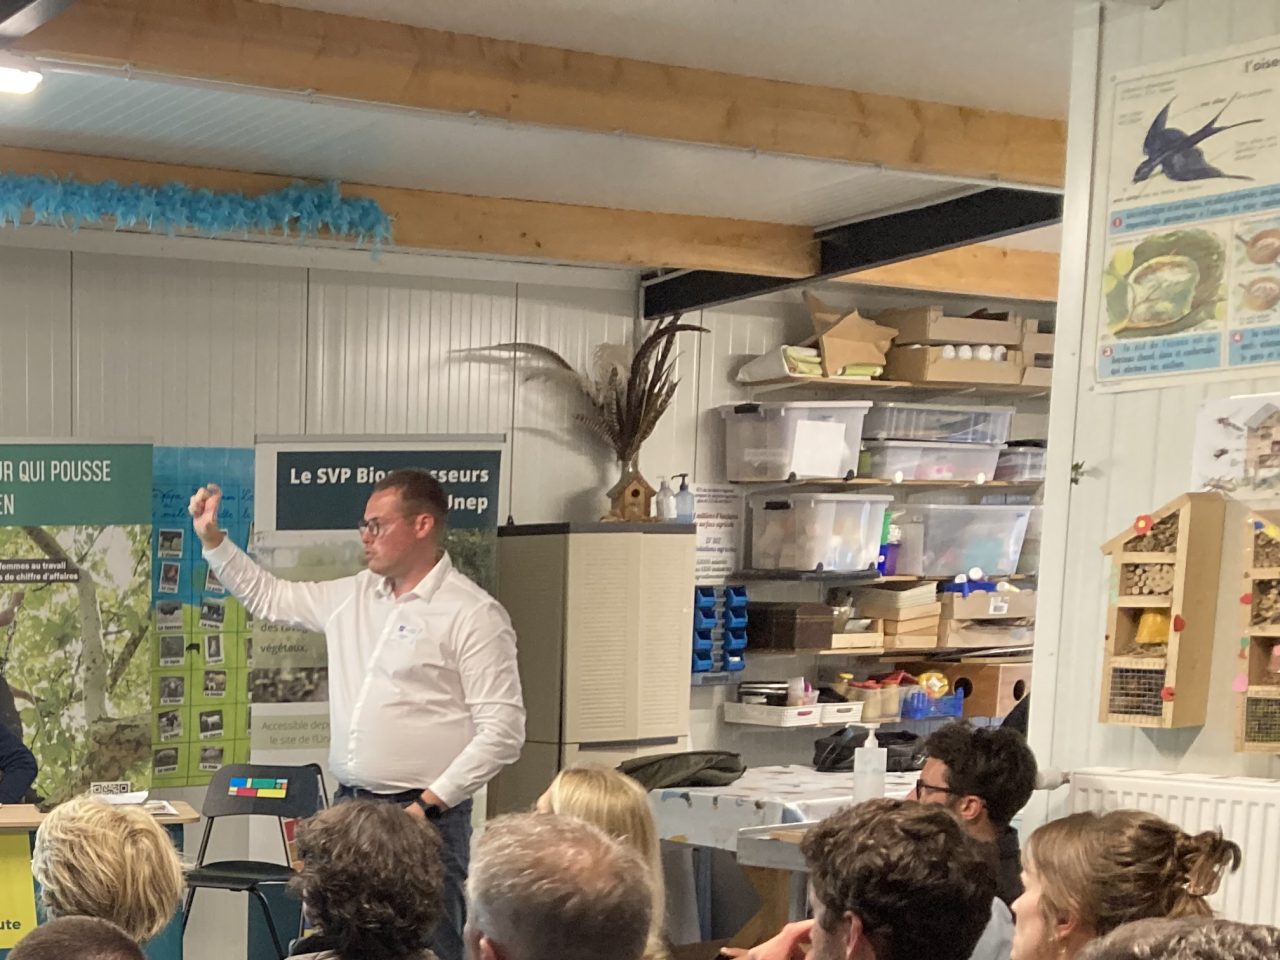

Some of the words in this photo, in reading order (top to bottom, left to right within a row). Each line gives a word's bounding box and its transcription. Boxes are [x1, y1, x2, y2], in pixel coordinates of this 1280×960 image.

[19, 460, 45, 483] QUI
[51, 460, 111, 482] POUSSE
[290, 468, 312, 484] Le
[317, 467, 351, 484] SVP
[0, 562, 29, 570] femmes
[42, 561, 66, 570] travail
[4, 573, 14, 581] de
[16, 572, 41, 581] chiffre
[42, 572, 79, 581] d'affaires
